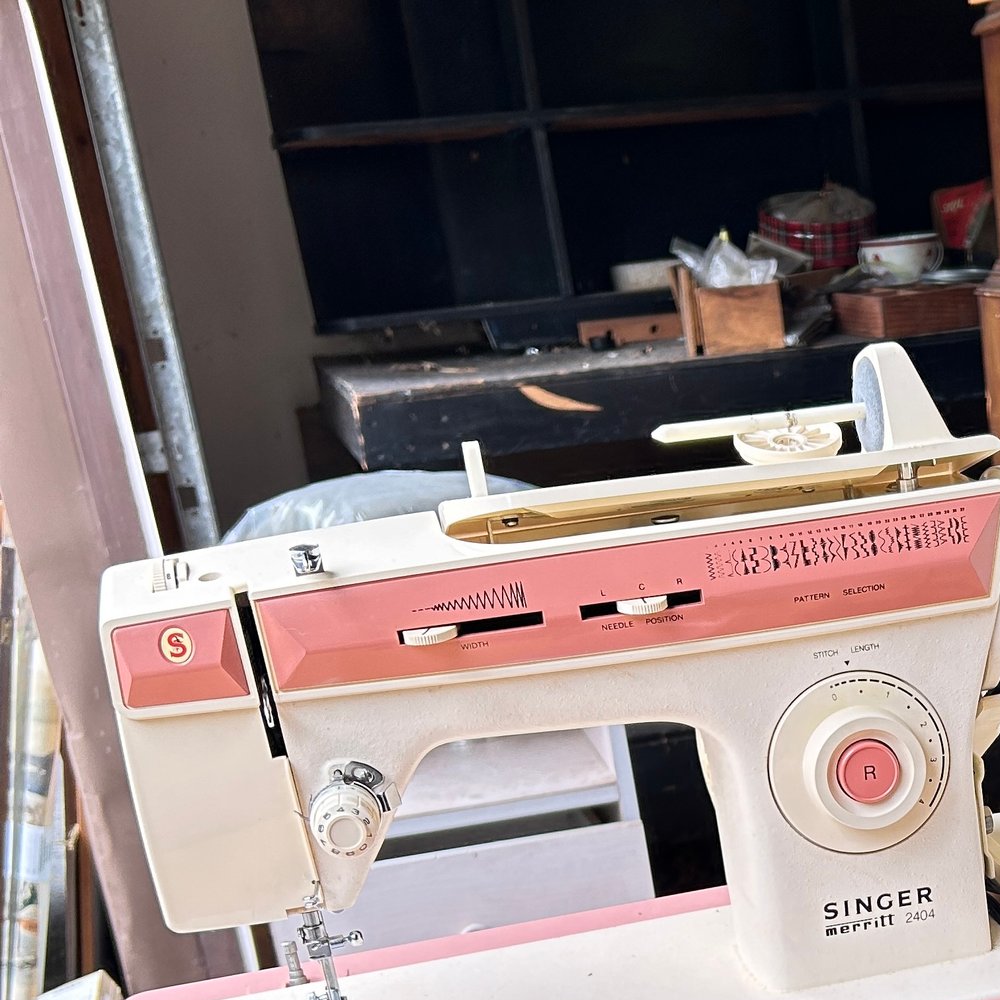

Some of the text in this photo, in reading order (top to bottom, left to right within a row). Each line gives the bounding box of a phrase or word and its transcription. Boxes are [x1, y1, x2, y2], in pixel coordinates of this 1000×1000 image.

[600, 577, 683, 597] L C R
[793, 583, 886, 604] PATTERN SELECTION
[601, 614, 684, 631] NEEDLE POSITION
[167, 633, 187, 658] S
[460, 640, 490, 650] WIDTH
[812, 642, 880, 660] STITCH LENGTH
[863, 764, 877, 781] R
[823, 886, 934, 920] SINGER
[825, 908, 935, 937] merritt 2404
